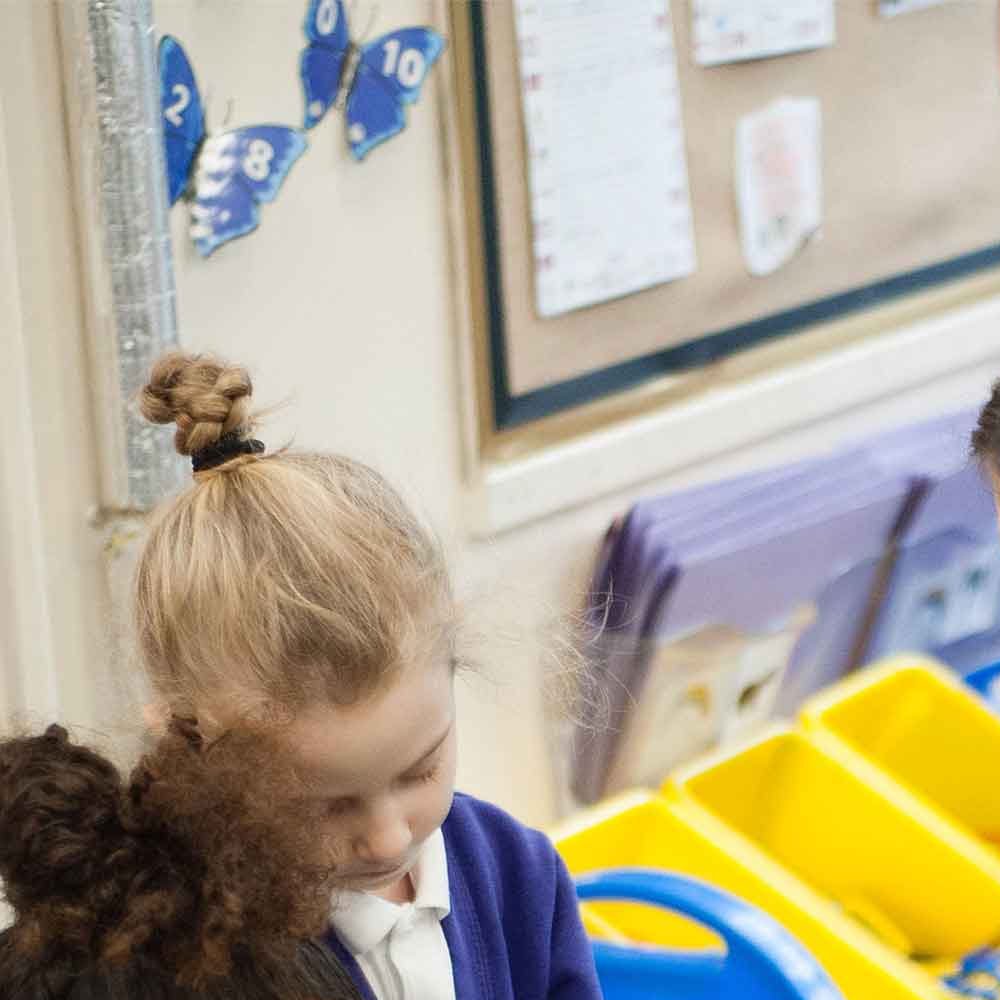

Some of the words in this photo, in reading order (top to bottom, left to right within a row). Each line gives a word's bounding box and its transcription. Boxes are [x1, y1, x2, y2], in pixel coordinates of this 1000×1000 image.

[383, 39, 425, 88] 10
[164, 83, 191, 128] 2
[242, 139, 274, 182] 8
